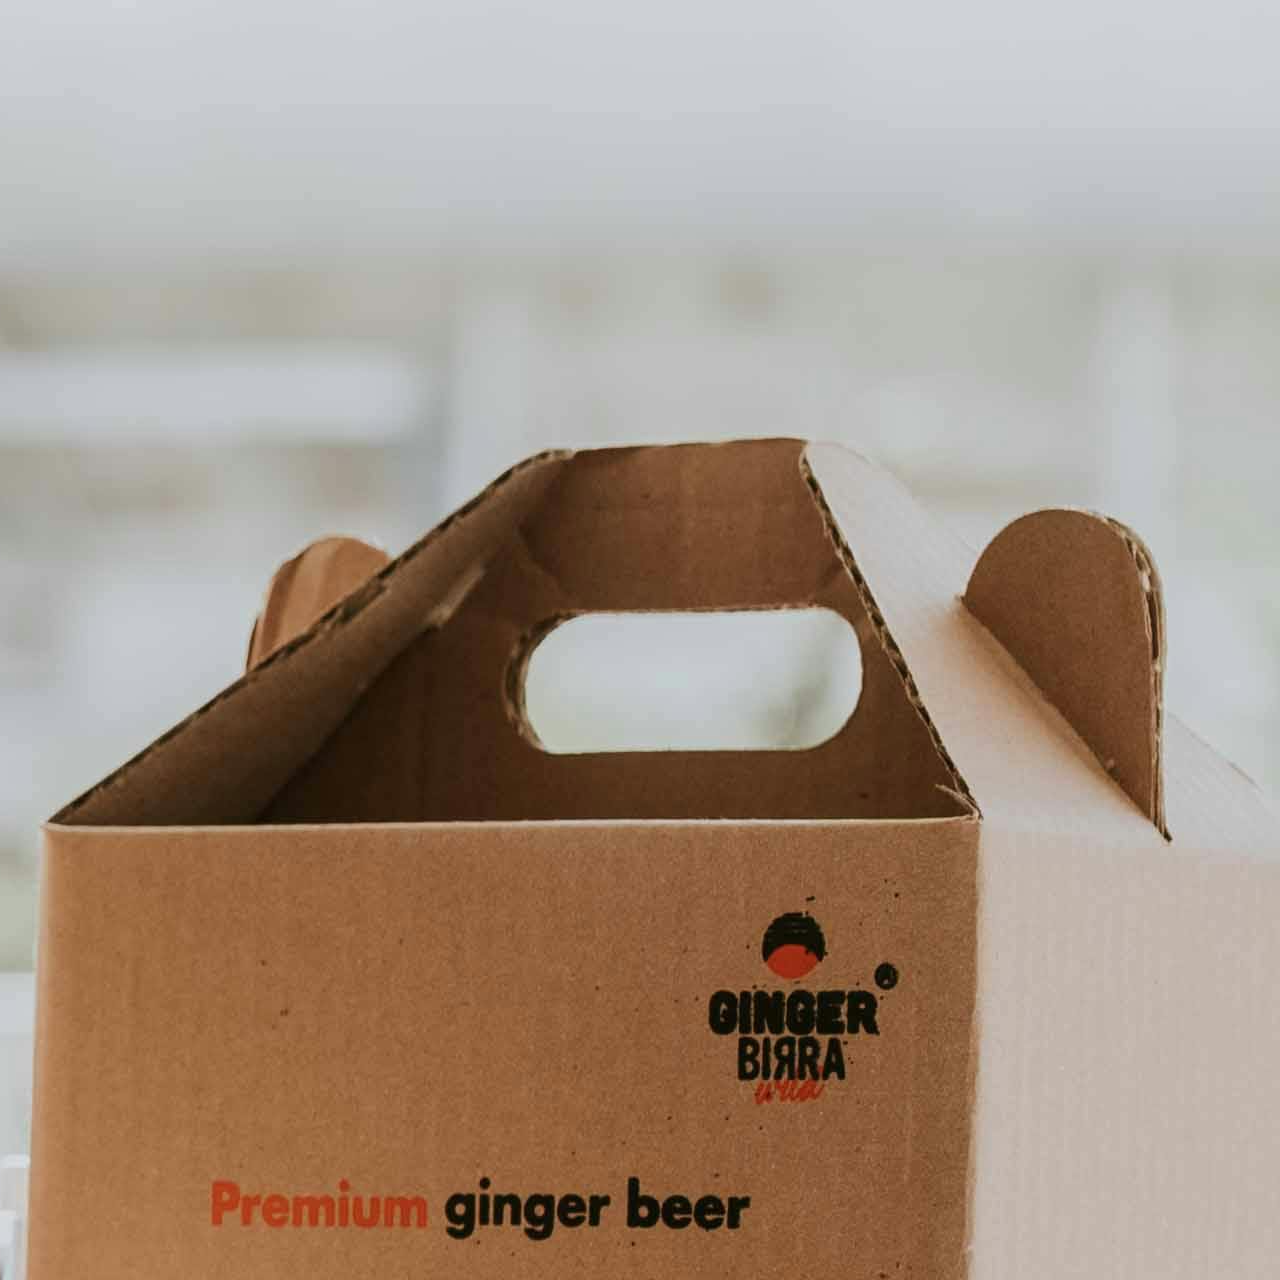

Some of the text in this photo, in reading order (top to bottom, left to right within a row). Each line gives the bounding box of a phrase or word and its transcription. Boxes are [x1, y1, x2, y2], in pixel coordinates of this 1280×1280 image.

[709, 990, 879, 1036] GINGER
[211, 1177, 750, 1240] Premium ginger beer
